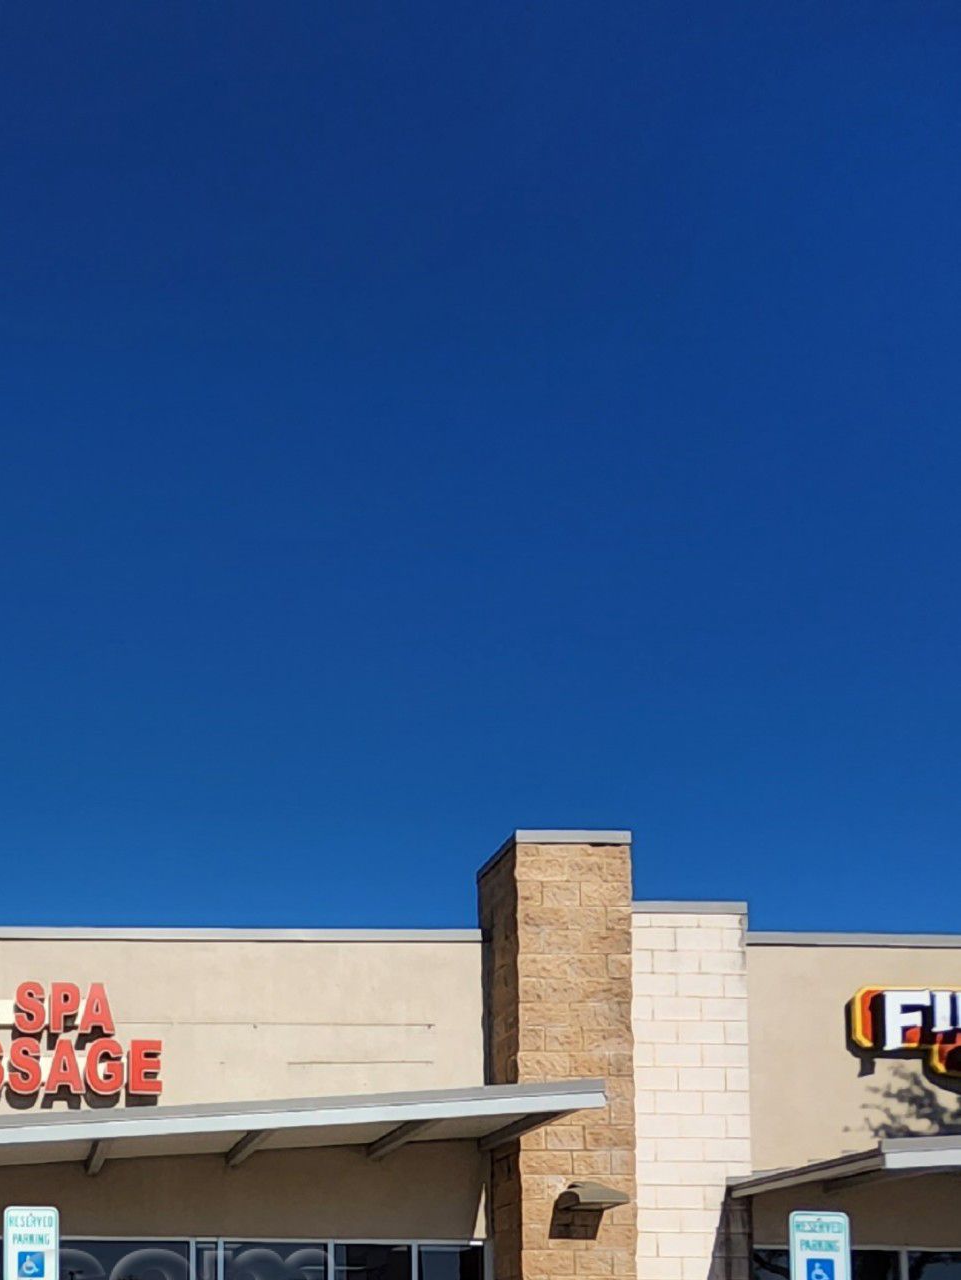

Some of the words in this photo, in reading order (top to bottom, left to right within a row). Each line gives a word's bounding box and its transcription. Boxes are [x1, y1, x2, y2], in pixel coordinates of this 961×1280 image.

[14, 981, 115, 1035] SPA
[882, 989, 961, 1050] FI
[8, 1215, 53, 1227] RESERVED
[12, 1233, 50, 1245] PARKING
